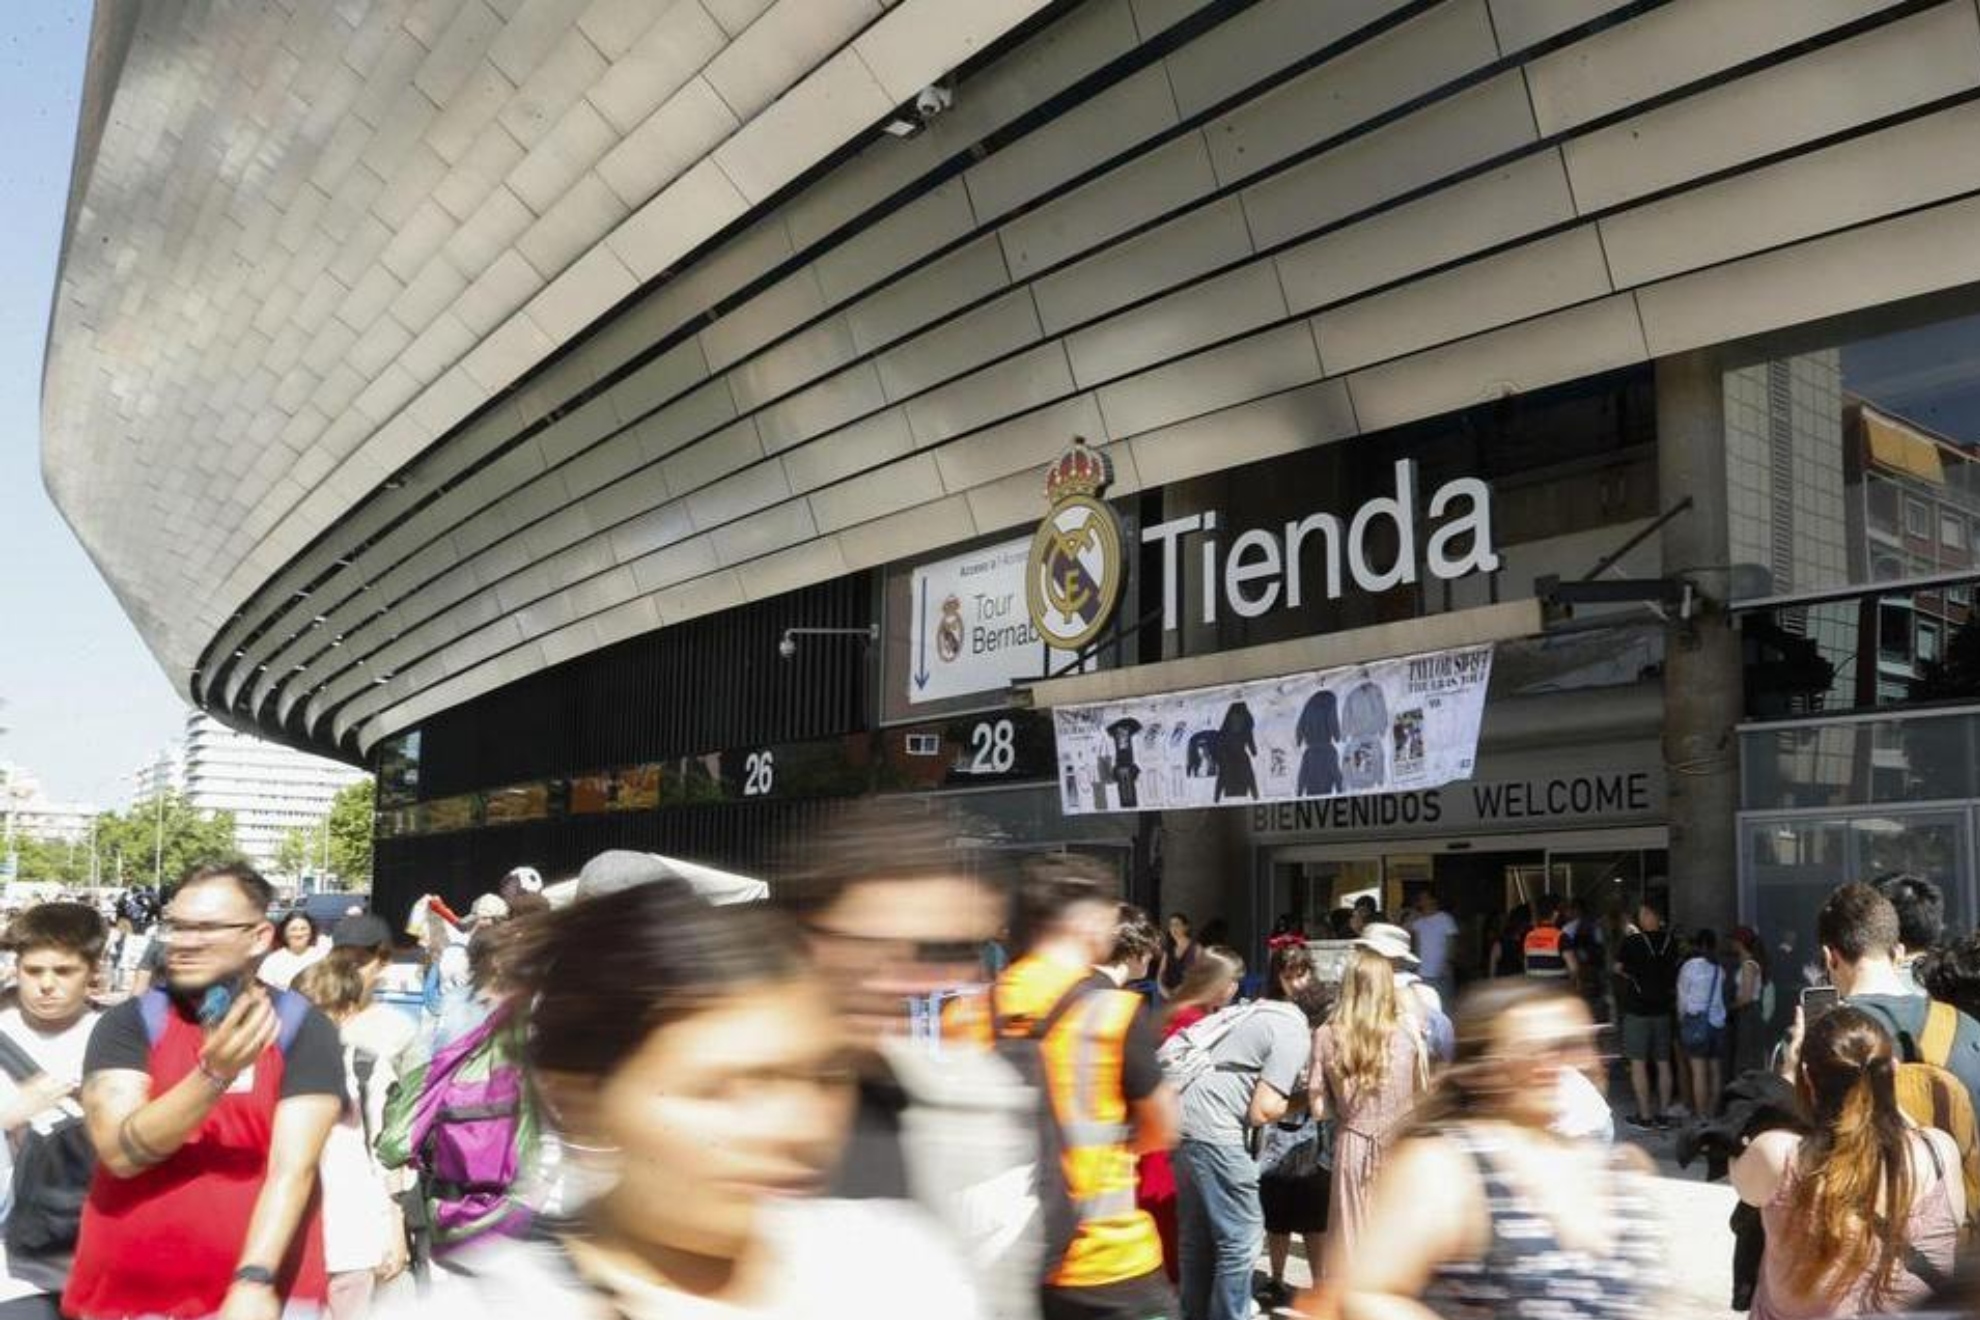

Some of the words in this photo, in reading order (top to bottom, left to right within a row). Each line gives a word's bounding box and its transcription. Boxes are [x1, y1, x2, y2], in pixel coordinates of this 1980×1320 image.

[1141, 457, 1499, 632] Tienda
[973, 592, 1014, 622] Tour
[972, 623, 1039, 655] Bernab
[971, 719, 1015, 773] 28
[744, 751, 773, 795] 26
[1252, 790, 1442, 832] BIENVENIDOS
[1473, 773, 1649, 818] WELCOME
